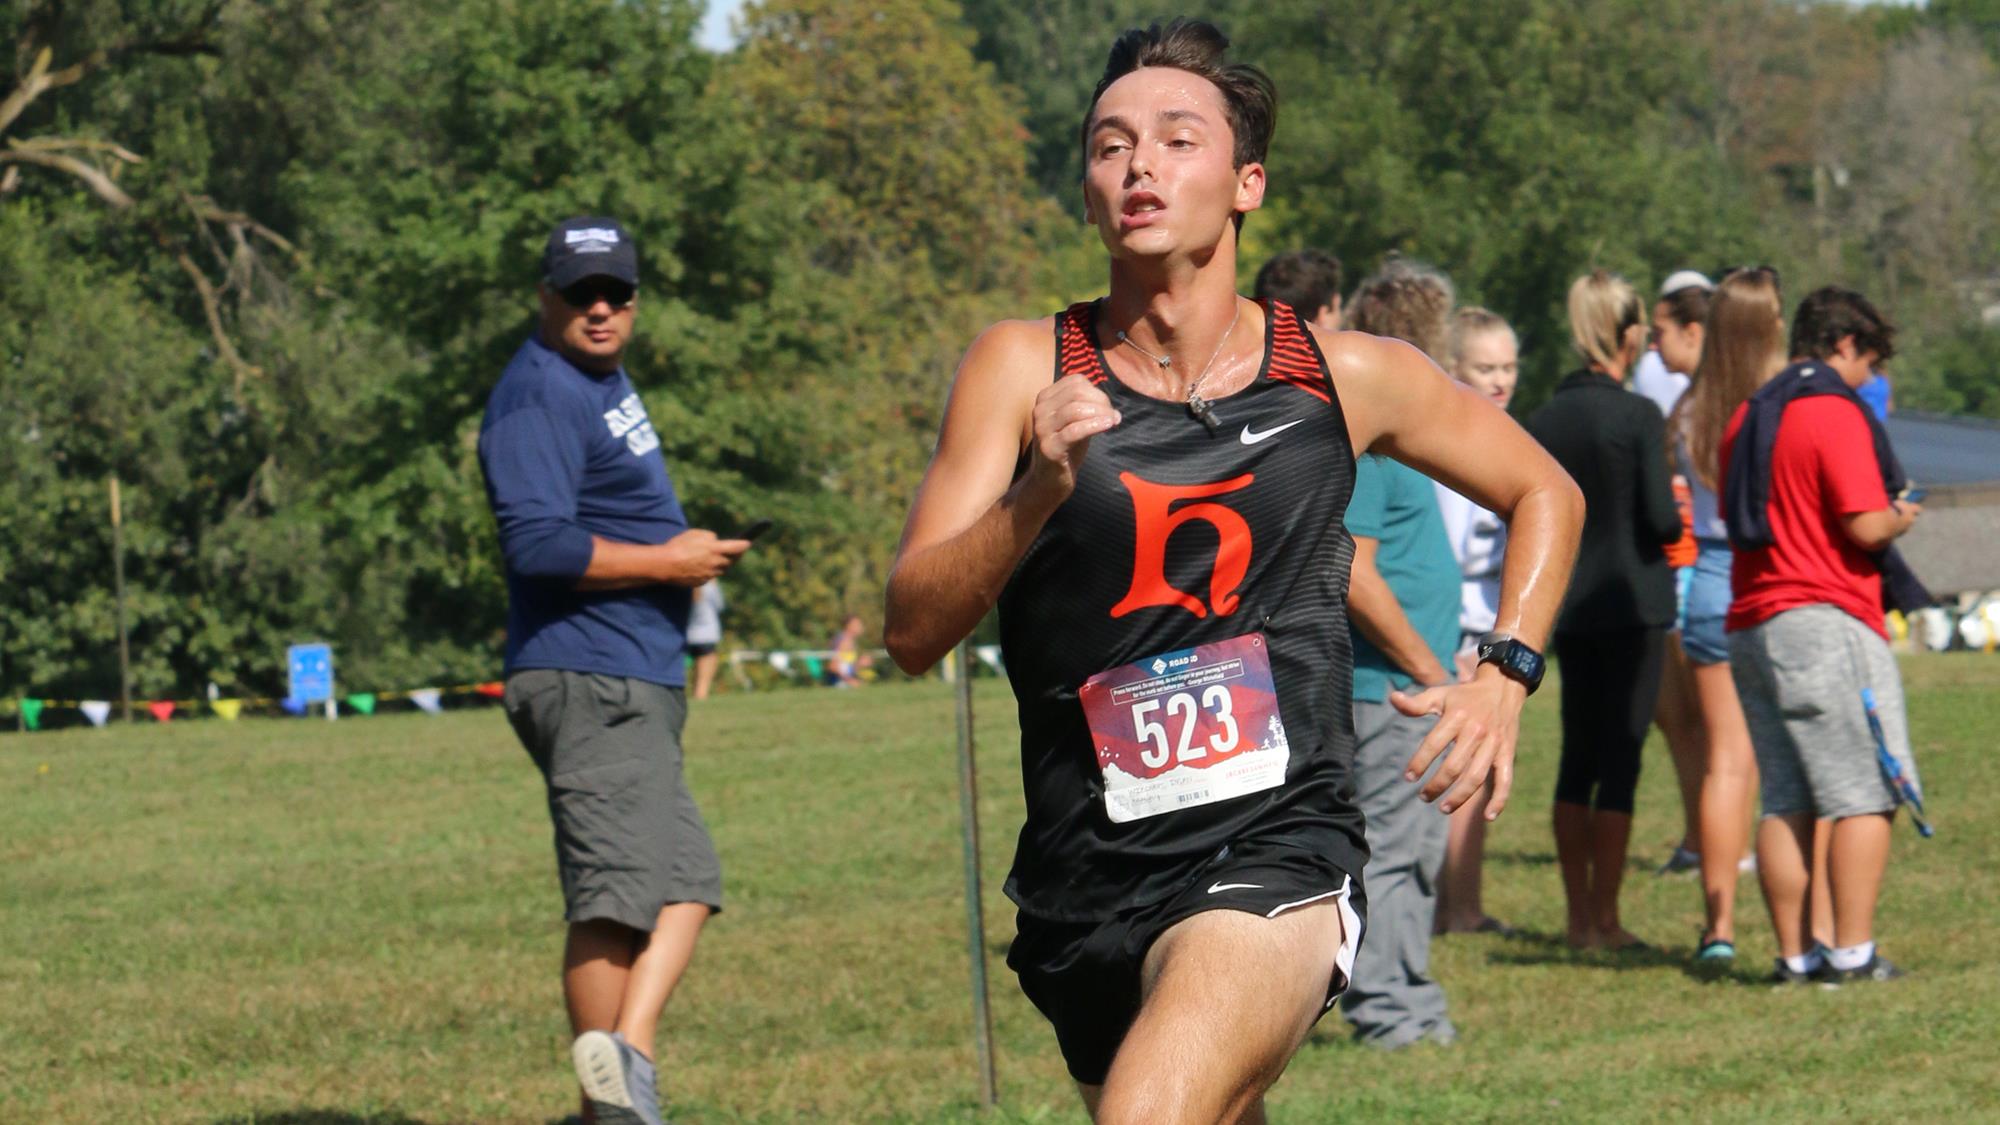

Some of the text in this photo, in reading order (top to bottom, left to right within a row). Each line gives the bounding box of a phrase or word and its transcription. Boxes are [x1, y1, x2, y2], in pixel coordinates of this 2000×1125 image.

[1168, 654, 1198, 668] ROAD ID
[1132, 684, 1240, 768] 523
